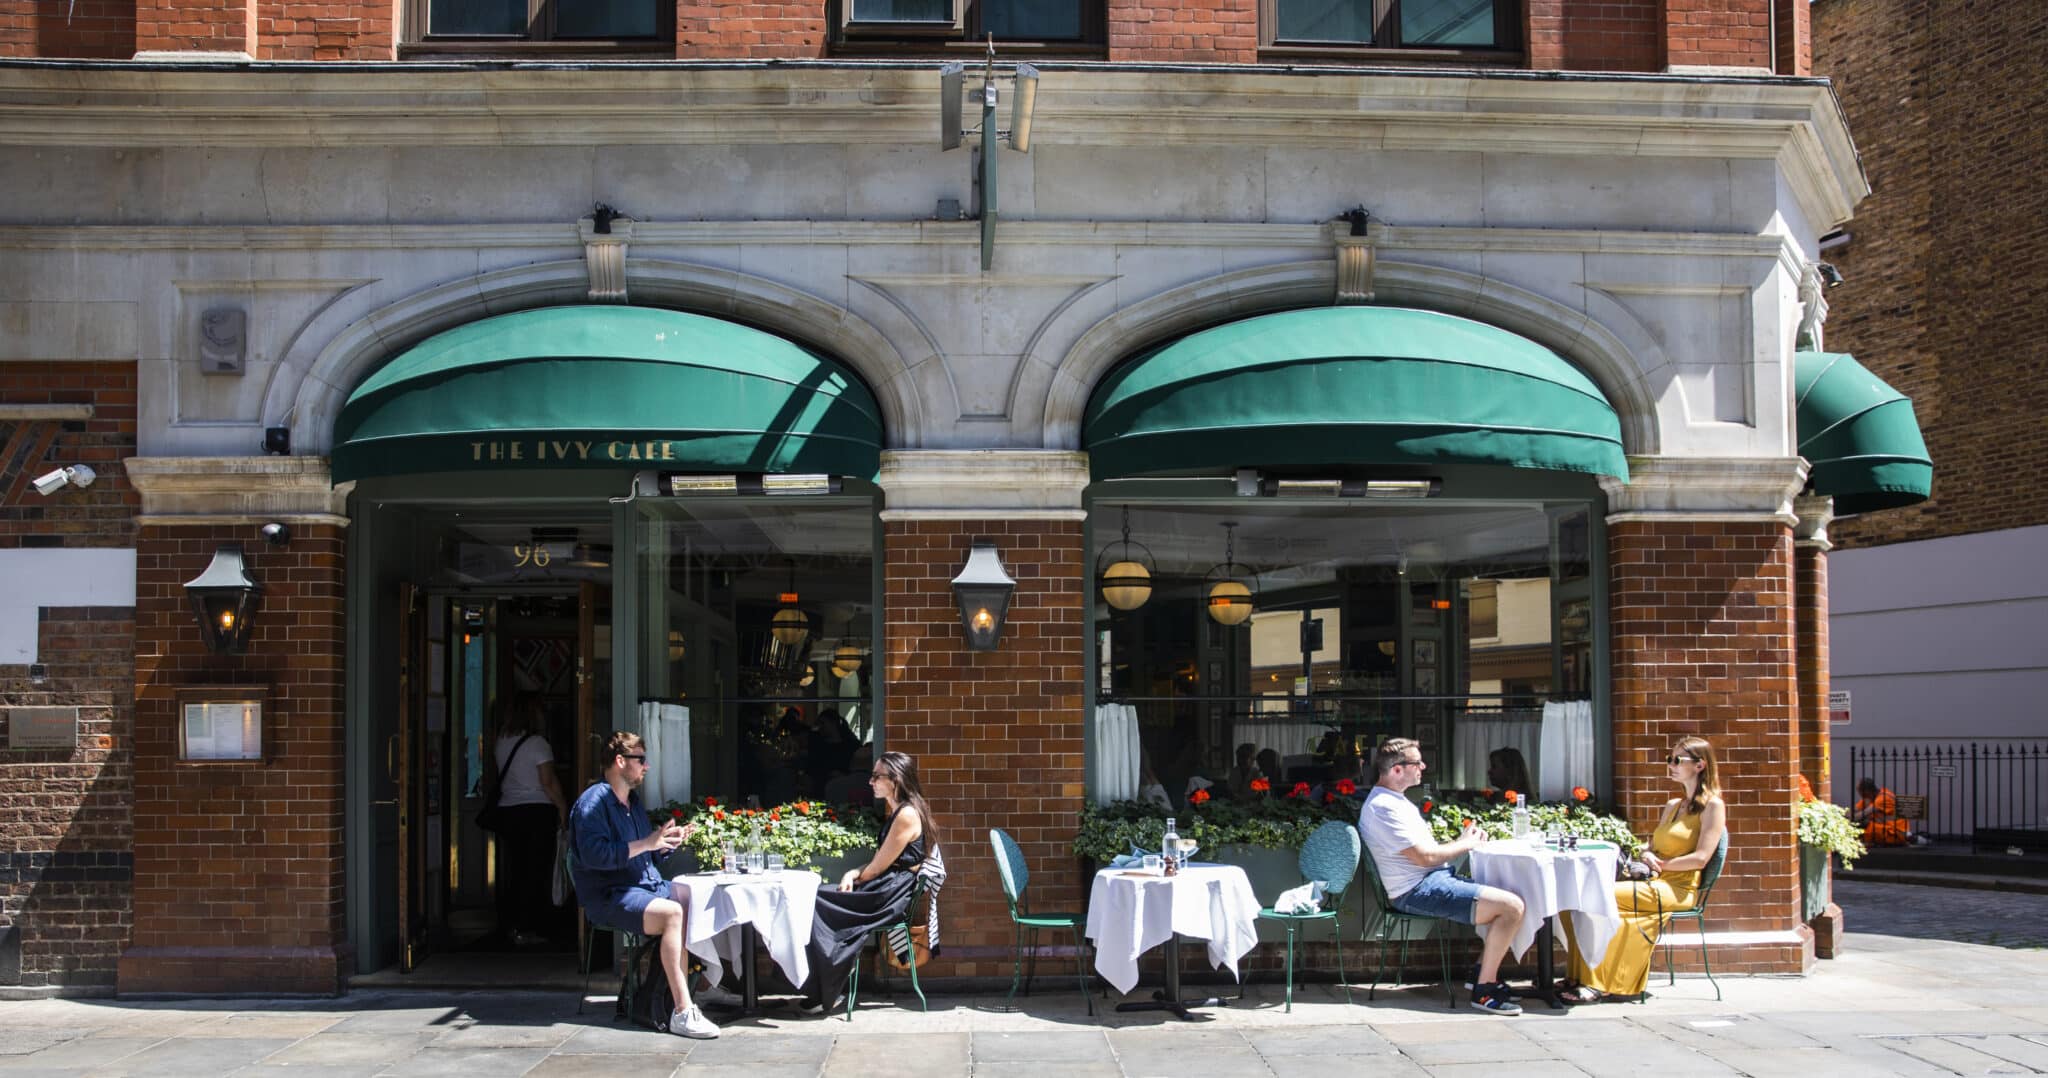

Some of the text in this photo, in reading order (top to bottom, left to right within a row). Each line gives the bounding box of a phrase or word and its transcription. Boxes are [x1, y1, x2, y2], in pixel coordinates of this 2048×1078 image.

[471, 440, 676, 461] THE IVY CAFE
[512, 543, 551, 568] 96
